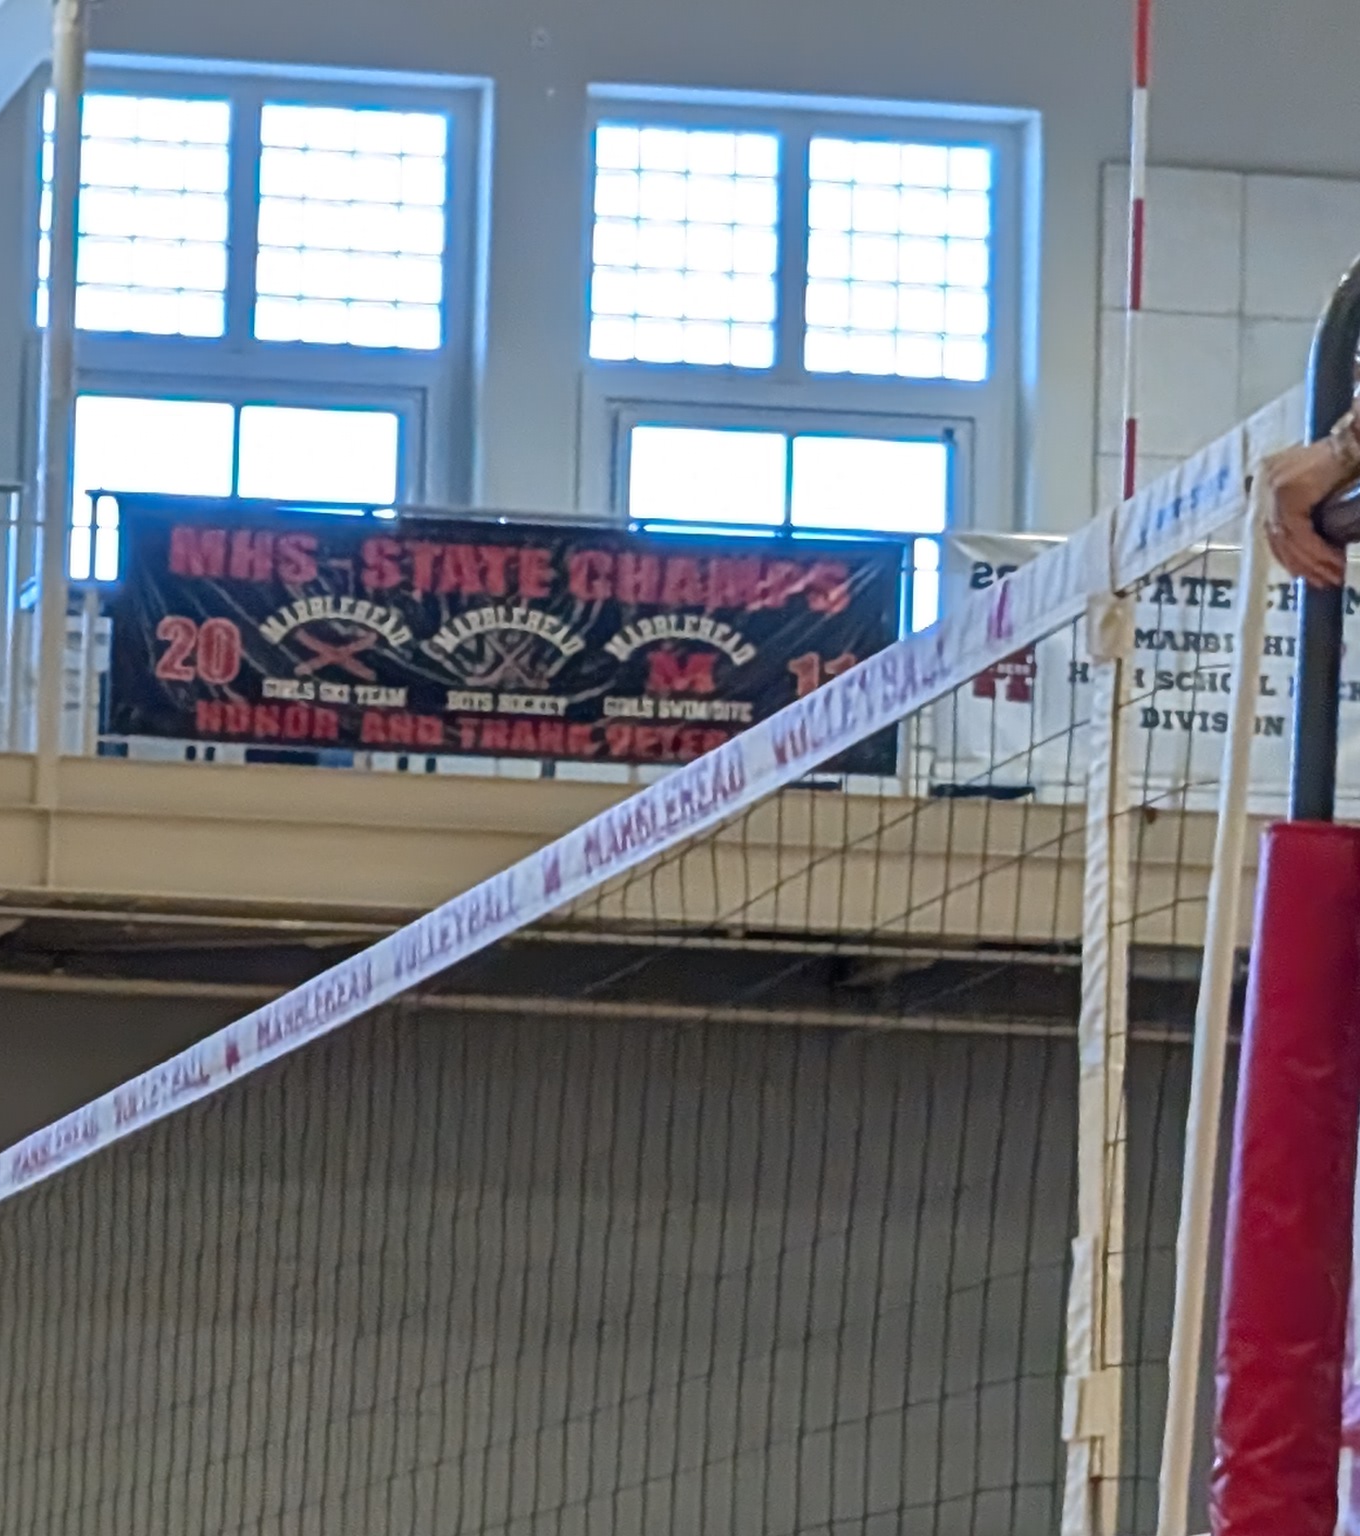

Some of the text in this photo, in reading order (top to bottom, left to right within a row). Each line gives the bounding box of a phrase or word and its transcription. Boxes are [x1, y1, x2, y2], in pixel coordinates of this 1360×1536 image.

[169, 526, 851, 614] MHS STATE CHAMPS
[259, 596, 413, 648] MARBLEHEAD
[433, 606, 585, 656] MARBLEHEAD
[604, 614, 757, 666] MARBLEHEAD
[155, 615, 242, 685] 20
[647, 651, 717, 693] M
[354, 685, 407, 707] TEAM
[196, 700, 339, 740] HONOR
[361, 711, 443, 746] AND
[583, 742, 746, 875] MARBLEHEAD
